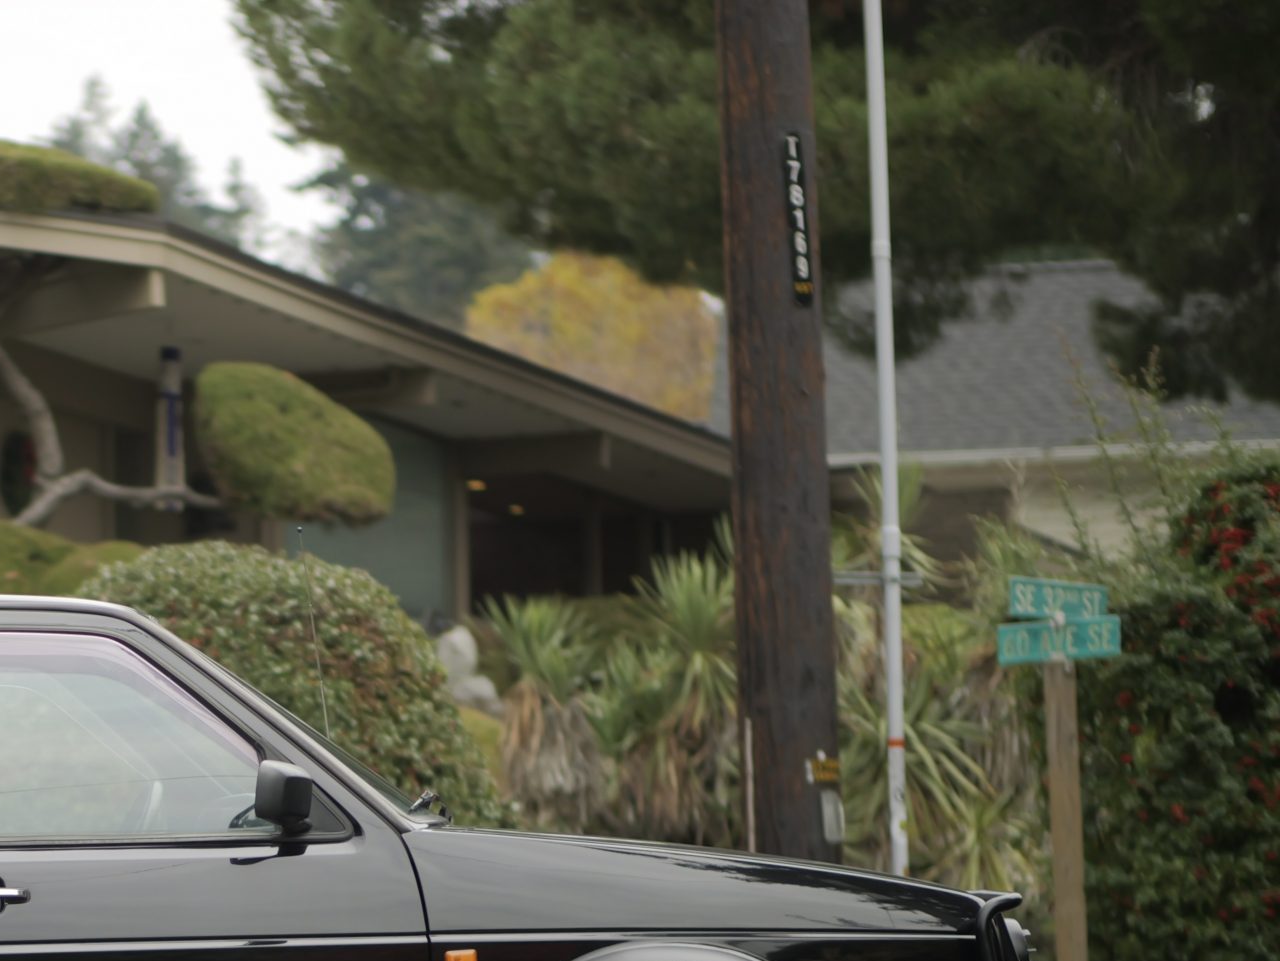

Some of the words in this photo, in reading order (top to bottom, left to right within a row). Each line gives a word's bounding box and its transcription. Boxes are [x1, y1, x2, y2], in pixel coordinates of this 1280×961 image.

[1014, 583, 1036, 613] SE
[1082, 591, 1102, 618] ST
[1087, 622, 1114, 650] SE
